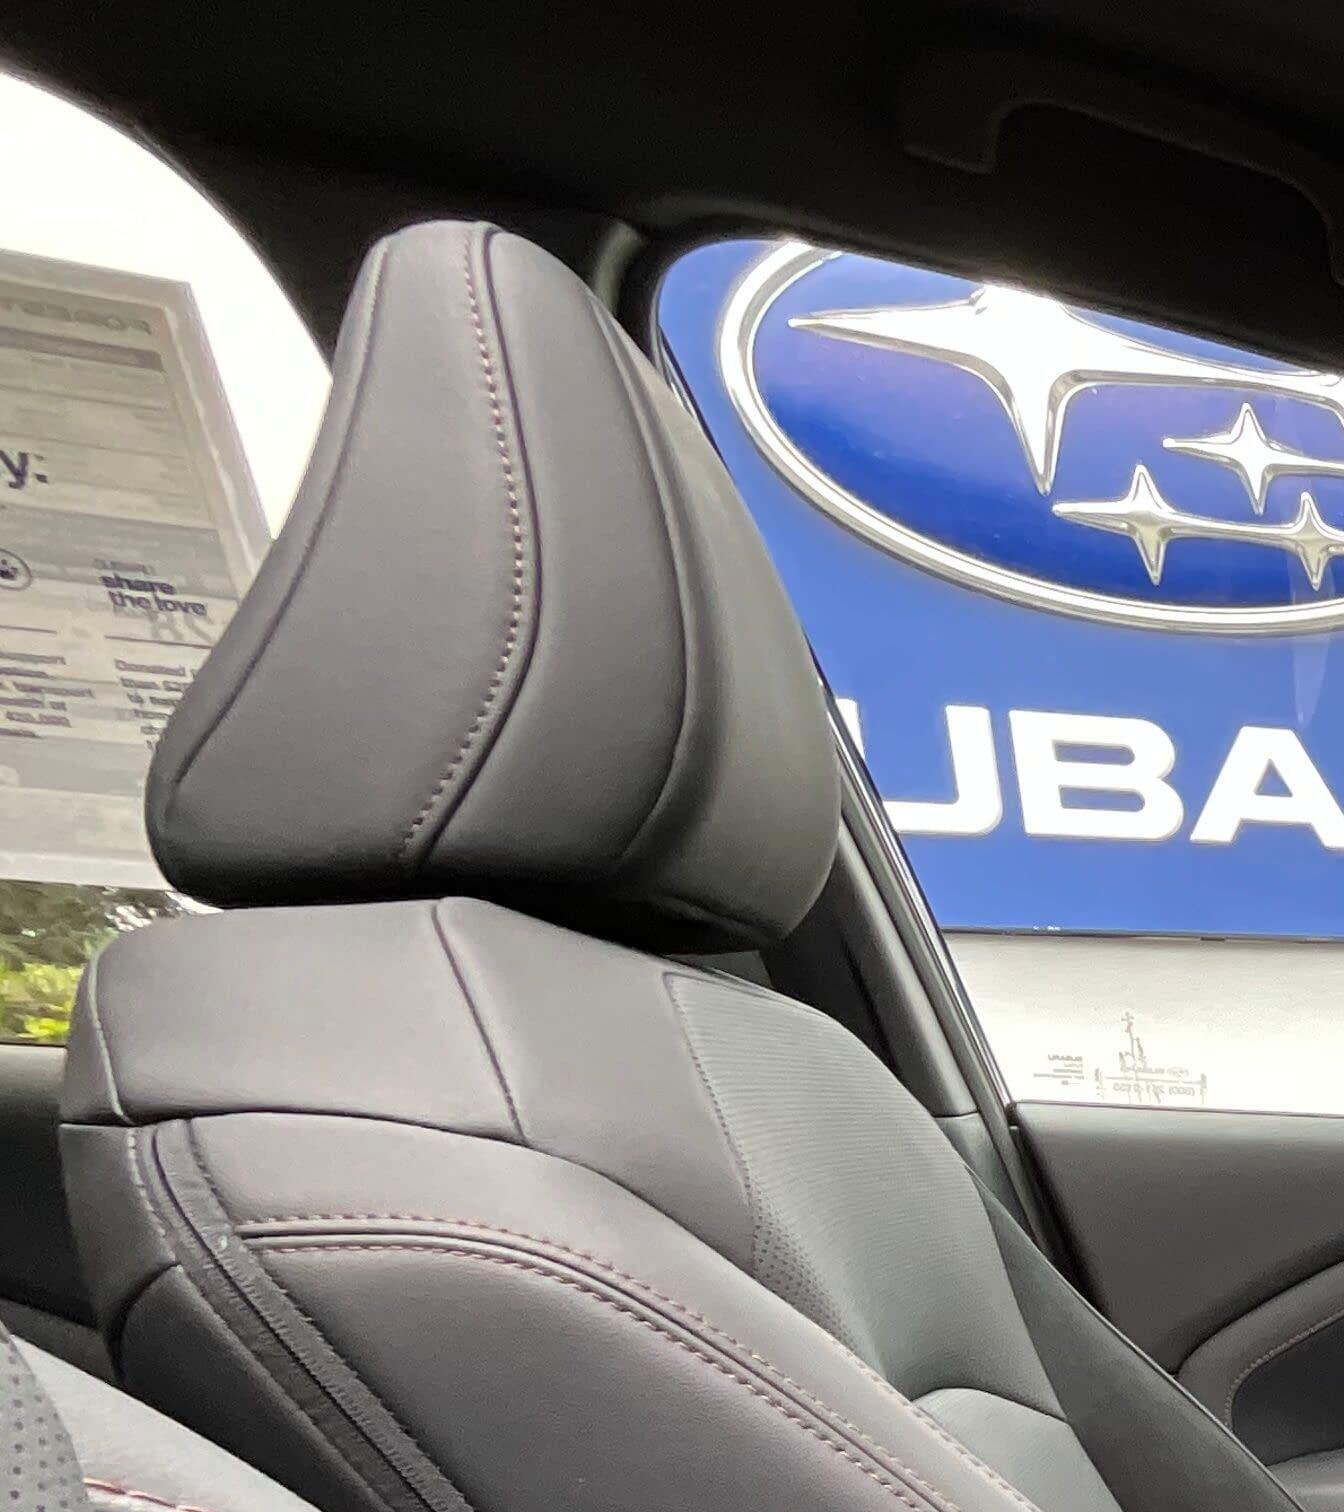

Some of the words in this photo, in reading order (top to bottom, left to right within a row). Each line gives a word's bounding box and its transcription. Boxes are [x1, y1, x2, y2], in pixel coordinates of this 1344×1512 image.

[100, 572, 176, 595] share
[109, 590, 151, 610] the
[153, 589, 207, 616] love
